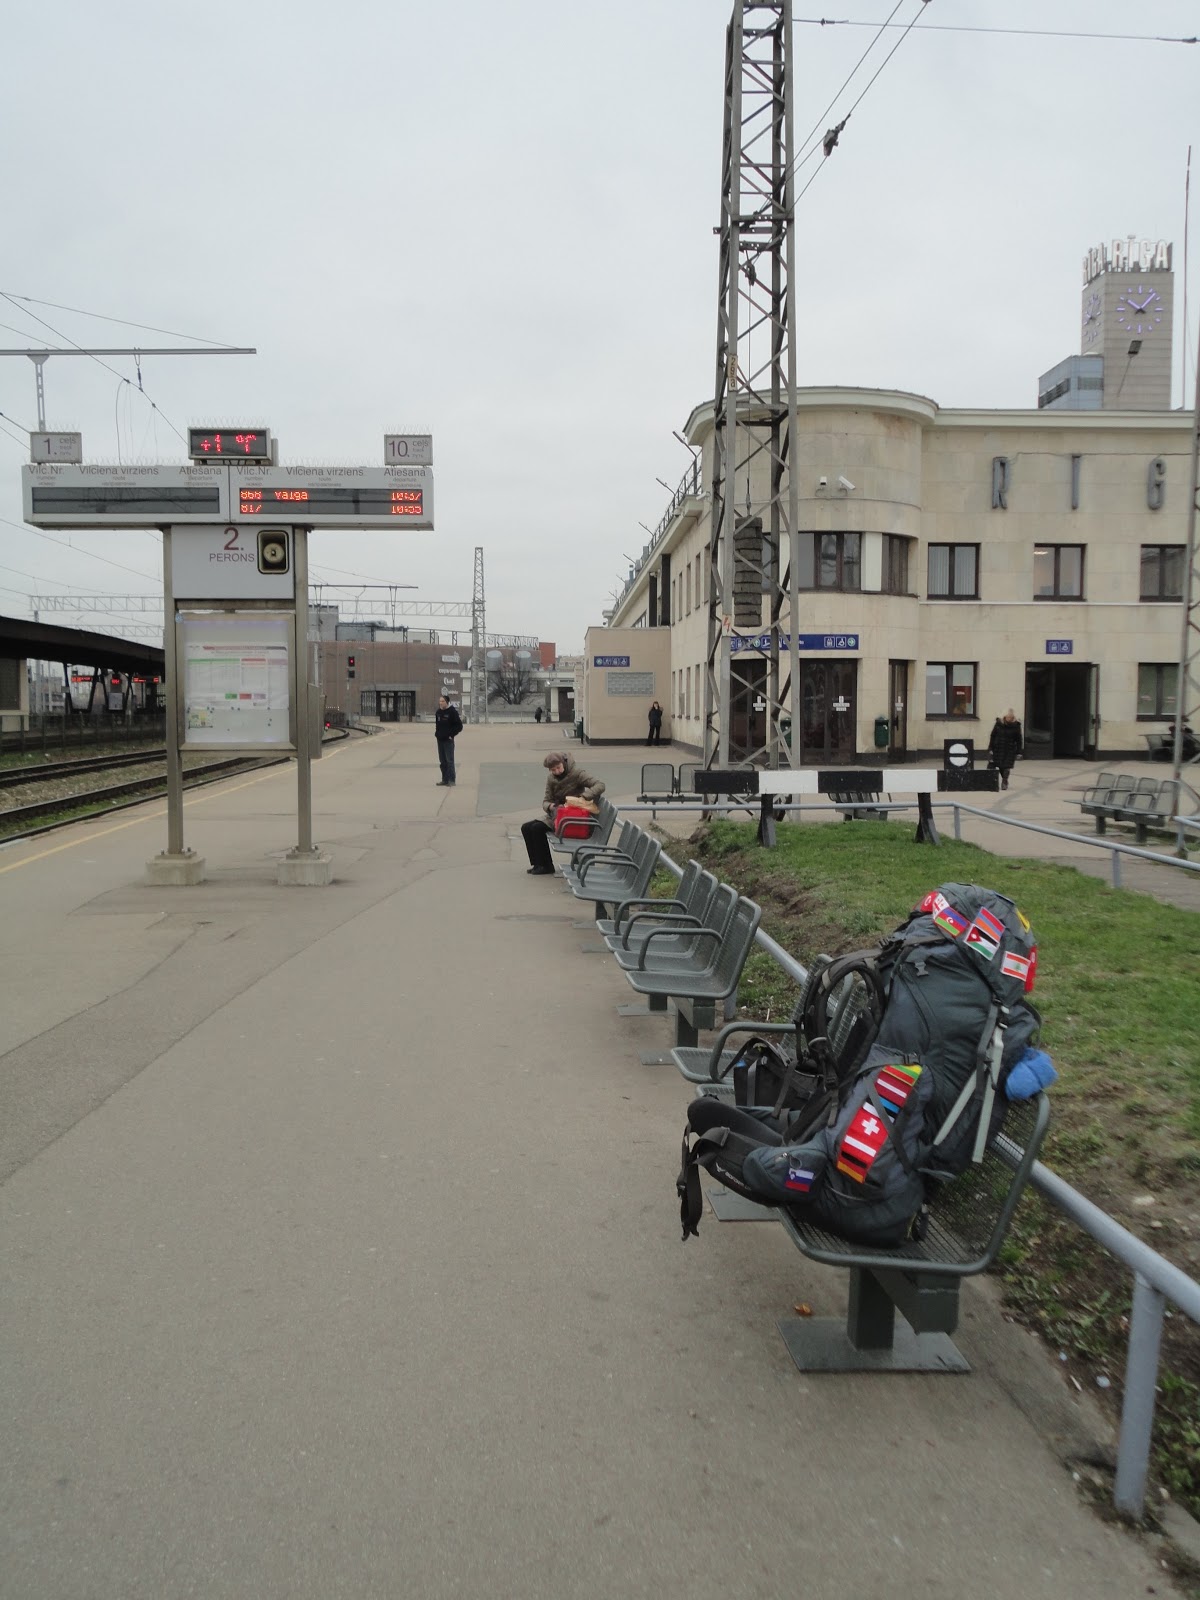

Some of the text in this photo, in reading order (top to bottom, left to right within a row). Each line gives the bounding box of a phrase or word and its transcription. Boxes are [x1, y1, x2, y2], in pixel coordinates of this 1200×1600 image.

[1111, 235, 1170, 270] RĪGA
[43, 437, 58, 455] 1.
[388, 440, 410, 458] 10.
[79, 465, 160, 476] Vilciena virziens
[285, 466, 364, 477] Vilciena virziens
[383, 467, 427, 477] Atiešana
[223, 526, 245, 551] 2.
[209, 552, 255, 563] PERONS
